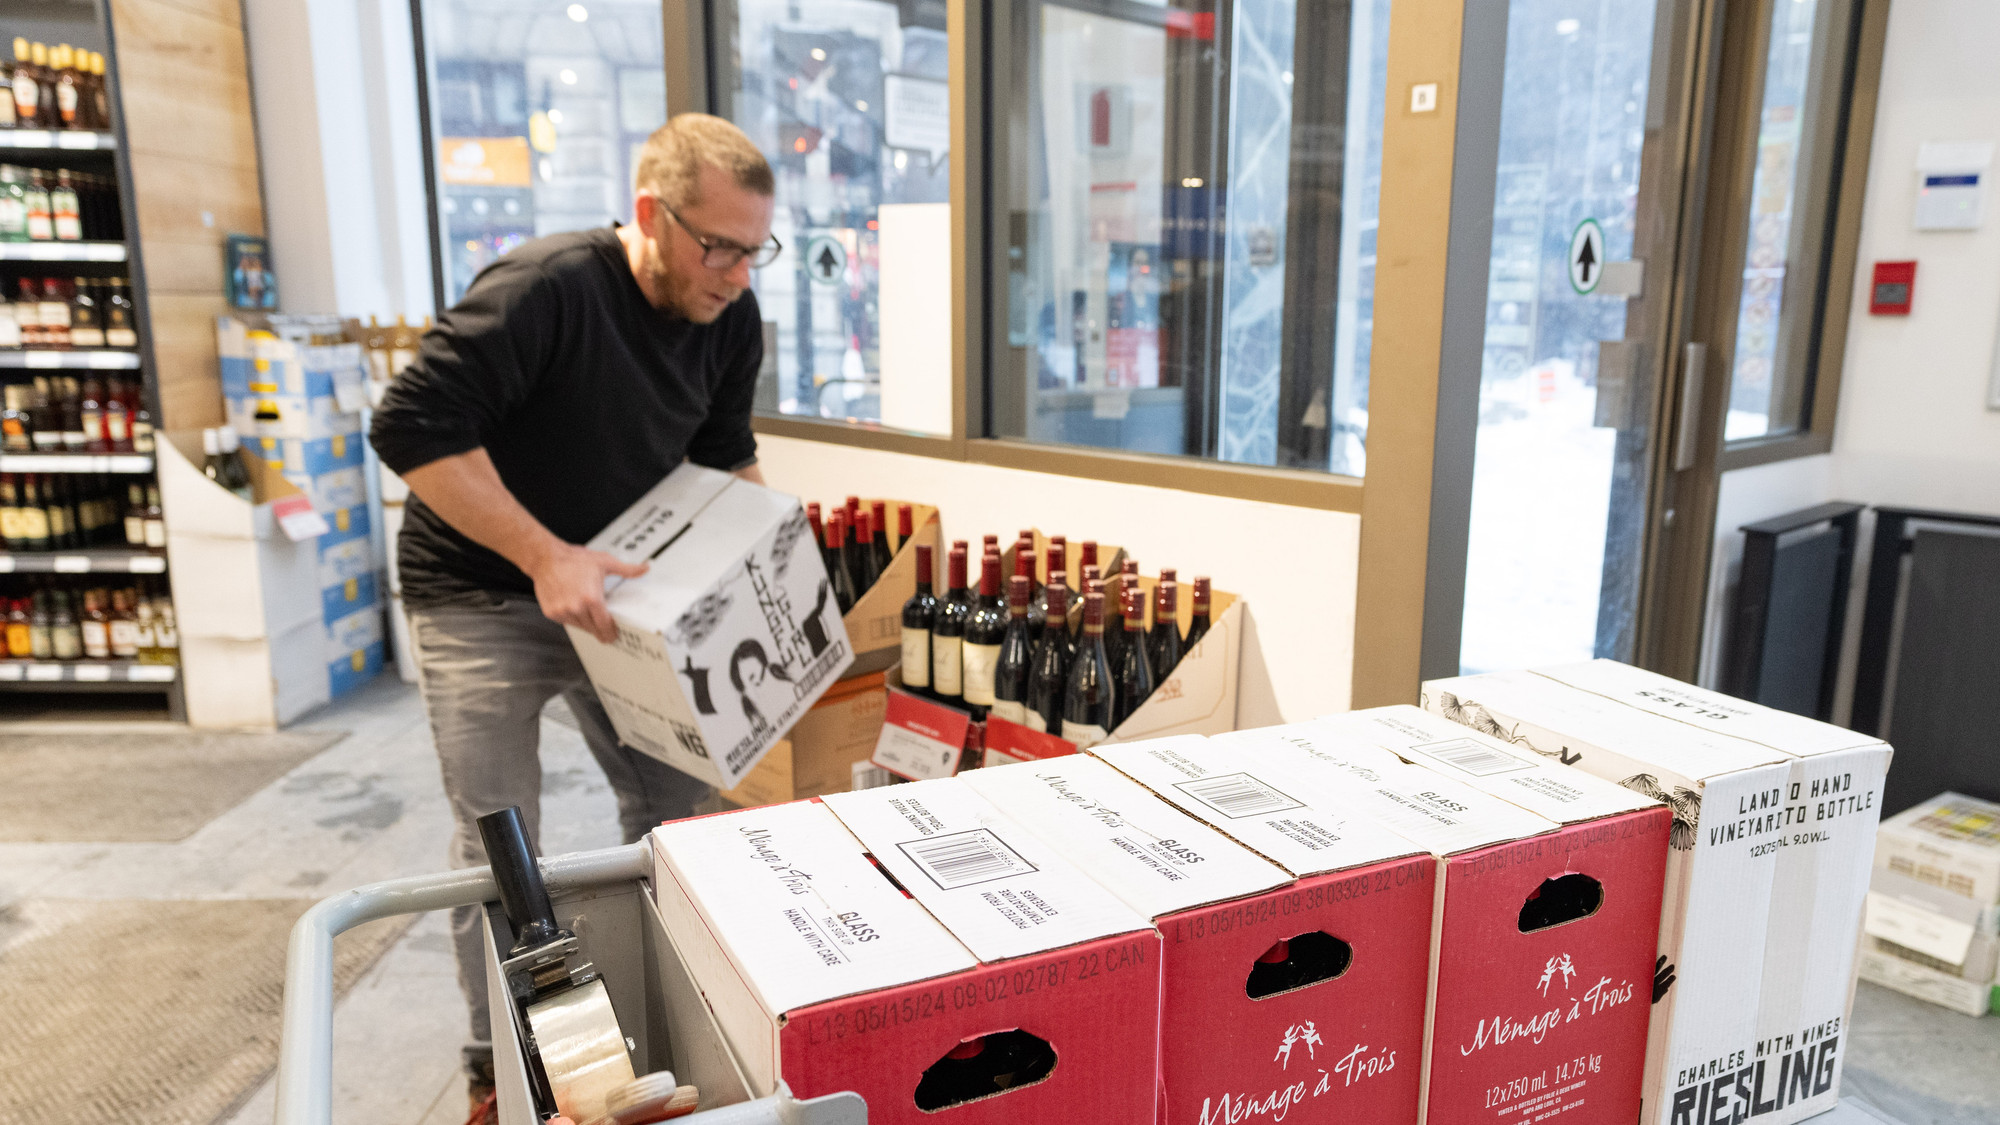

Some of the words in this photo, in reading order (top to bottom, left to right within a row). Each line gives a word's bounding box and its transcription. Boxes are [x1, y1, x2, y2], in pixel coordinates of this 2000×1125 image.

[1634, 690, 1729, 720] GLASS
[888, 798, 911, 816] TWELVE
[906, 798, 931, 817] BOTTLES
[1035, 773, 1086, 803] Ménage
[1091, 807, 1124, 829] Trois
[1375, 788, 1409, 805] HANDLE
[1407, 803, 1432, 816] WITH
[1430, 813, 1457, 826] CARE
[1419, 791, 1469, 813] GLASS
[1739, 788, 1780, 815] LAND
[1810, 773, 1851, 799] HAND
[1816, 791, 1874, 821] BOTTLE
[906, 814, 934, 836] CONTAINS
[1265, 820, 1290, 835] FROM
[1279, 818, 1334, 848] TEMPERATURE
[1299, 819, 1342, 842] EXTREMES
[739, 826, 782, 863] Ménage
[1147, 843, 1162, 854] THIS
[1159, 849, 1175, 862] SIDE
[1172, 858, 1186, 866] UP
[1158, 839, 1205, 864] GLASS
[1287, 831, 1322, 851] PROTECT
[1489, 841, 1542, 871] 05/15/24
[1621, 819, 1635, 839] 22
[1638, 814, 1663, 836] CAN
[770, 862, 792, 872] à
[1109, 837, 1142, 856] HANDLE
[1137, 854, 1159, 869] WITH
[1156, 866, 1183, 882] CARE
[778, 869, 813, 895] Trois
[980, 891, 1003, 907] FROM
[998, 888, 1047, 925] TEMPERATURE
[1020, 889, 1059, 917] EXTREMES
[1210, 897, 1277, 935] 05/15/24
[1327, 877, 1370, 905] 03329
[1374, 870, 1392, 894] 22
[1396, 861, 1427, 888] CAN
[822, 916, 835, 929] THIS
[831, 927, 846, 939] SIDE
[841, 937, 854, 946] UP
[839, 911, 881, 943] GLASS
[996, 903, 1032, 930] PROTECT
[782, 908, 812, 933] HANDLE
[802, 931, 826, 952] WITH
[817, 948, 841, 967] CARE
[854, 990, 947, 1033] 05/15/24
[1013, 961, 1070, 997] 02787
[1078, 953, 1099, 981] 22
[1105, 942, 1146, 973] CAN
[1461, 1007, 1561, 1057] Ménage
[1566, 998, 1581, 1024] à
[1584, 976, 1634, 1016] Trois
[1677, 1050, 1745, 1087] CHARLES
[1755, 1033, 1794, 1058] MITH
[1802, 1017, 1841, 1046] WINES
[1197, 1080, 1307, 1125] Ménage
[1313, 1068, 1331, 1098] à
[1334, 1043, 1397, 1088] Trois
[1485, 1076, 1529, 1109] 12x750
[1531, 1070, 1548, 1093] mL
[1554, 1056, 1586, 1085] 14.75
[1588, 1054, 1602, 1073] kg
[1670, 1035, 1839, 1125] RIESLING
[1518, 1098, 1537, 1110] BOTTLED
